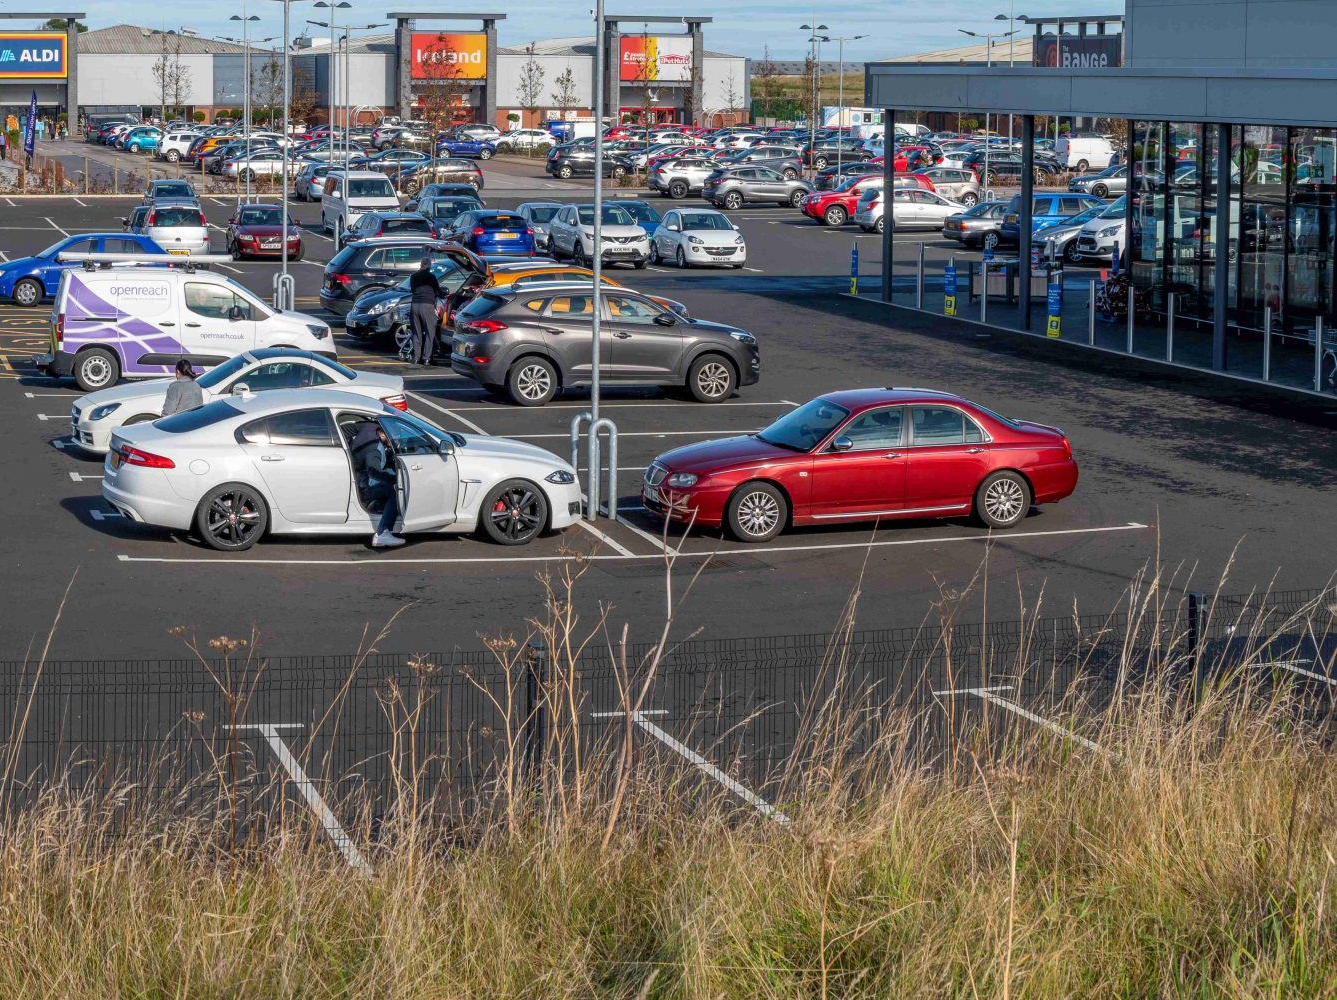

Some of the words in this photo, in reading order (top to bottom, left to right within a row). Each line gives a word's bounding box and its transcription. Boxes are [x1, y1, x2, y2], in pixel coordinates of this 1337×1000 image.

[19, 49, 59, 62] ALDI
[416, 48, 482, 64] Iceland
[109, 285, 168, 297] openreach
[200, 332, 245, 340] openreach.co.uk
